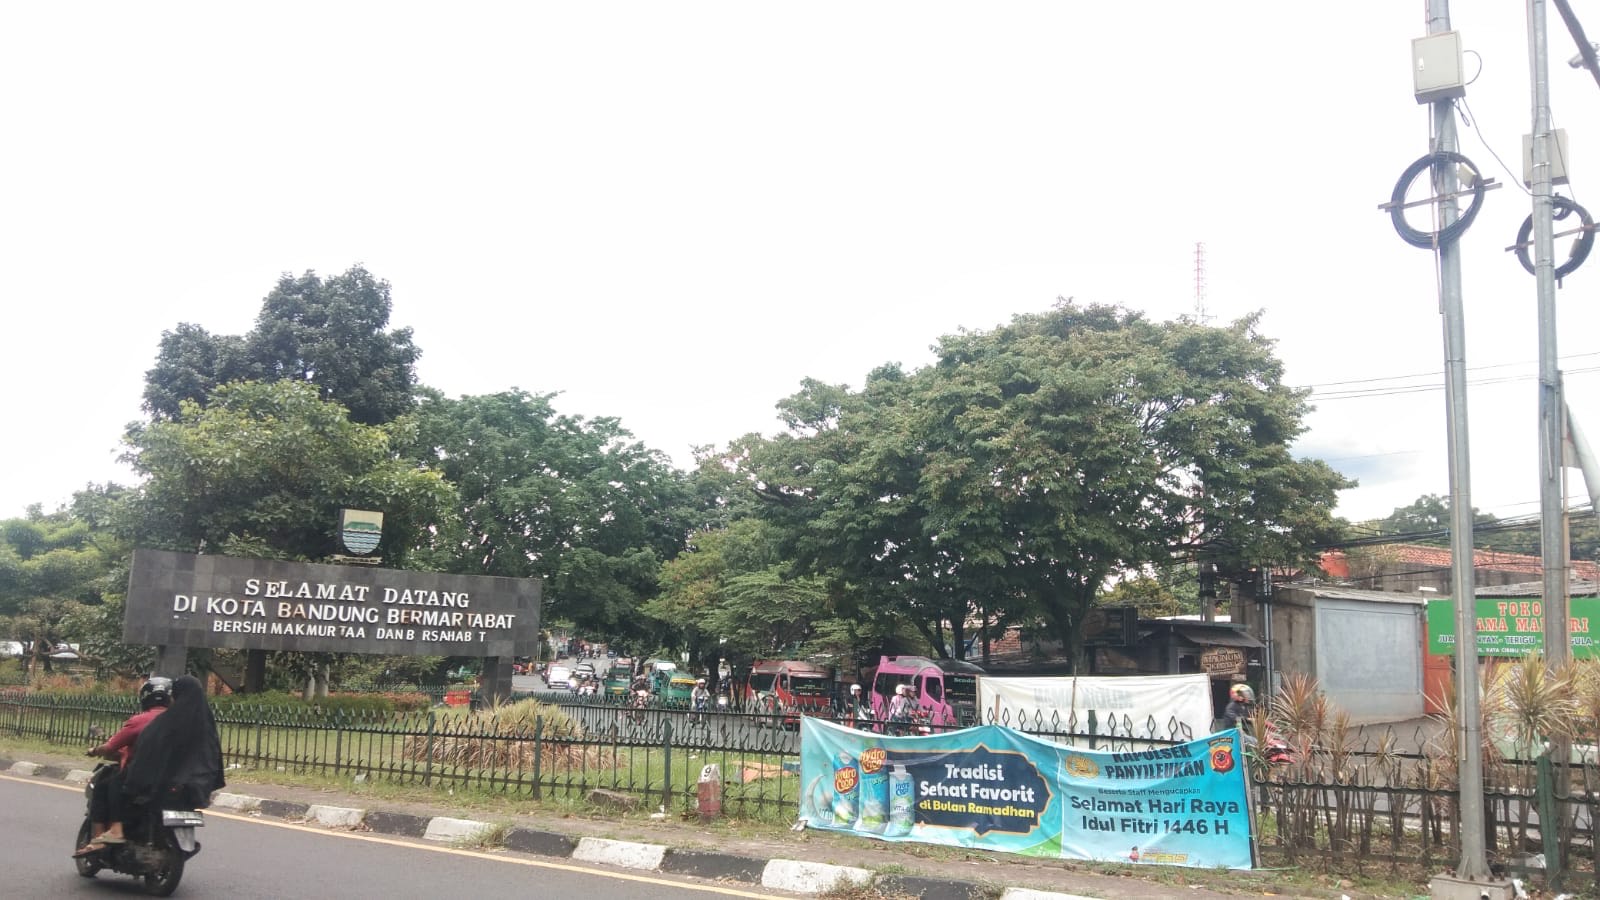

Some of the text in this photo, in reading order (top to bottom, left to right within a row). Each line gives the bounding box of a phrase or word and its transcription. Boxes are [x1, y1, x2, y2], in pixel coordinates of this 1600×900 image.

[245, 579, 470, 608] SELAMAT DATANG
[173, 595, 516, 629] DI KOTA BANDUNG BERMARTABAT
[1498, 601, 1542, 616] TOKO
[213, 620, 267, 634] BERSIH
[270, 622, 336, 637] MAKMUR
[1504, 635, 1536, 645] TERIGU
[860, 749, 885, 761] Hydro
[945, 763, 1004, 781] Tradisi
[1105, 760, 1205, 779] PANYILEUKAN
[836, 778, 854, 792] Coco
[920, 781, 1035, 802] Sehat Favorit
[1128, 788, 1146, 796] Staff
[1148, 787, 1200, 796] Mengucapkan
[919, 800, 1035, 818] di Bulan Ramadhan
[1070, 797, 1239, 816] Selamat Hari Raya
[1082, 815, 1229, 835] Idul Fitri 1446 H
